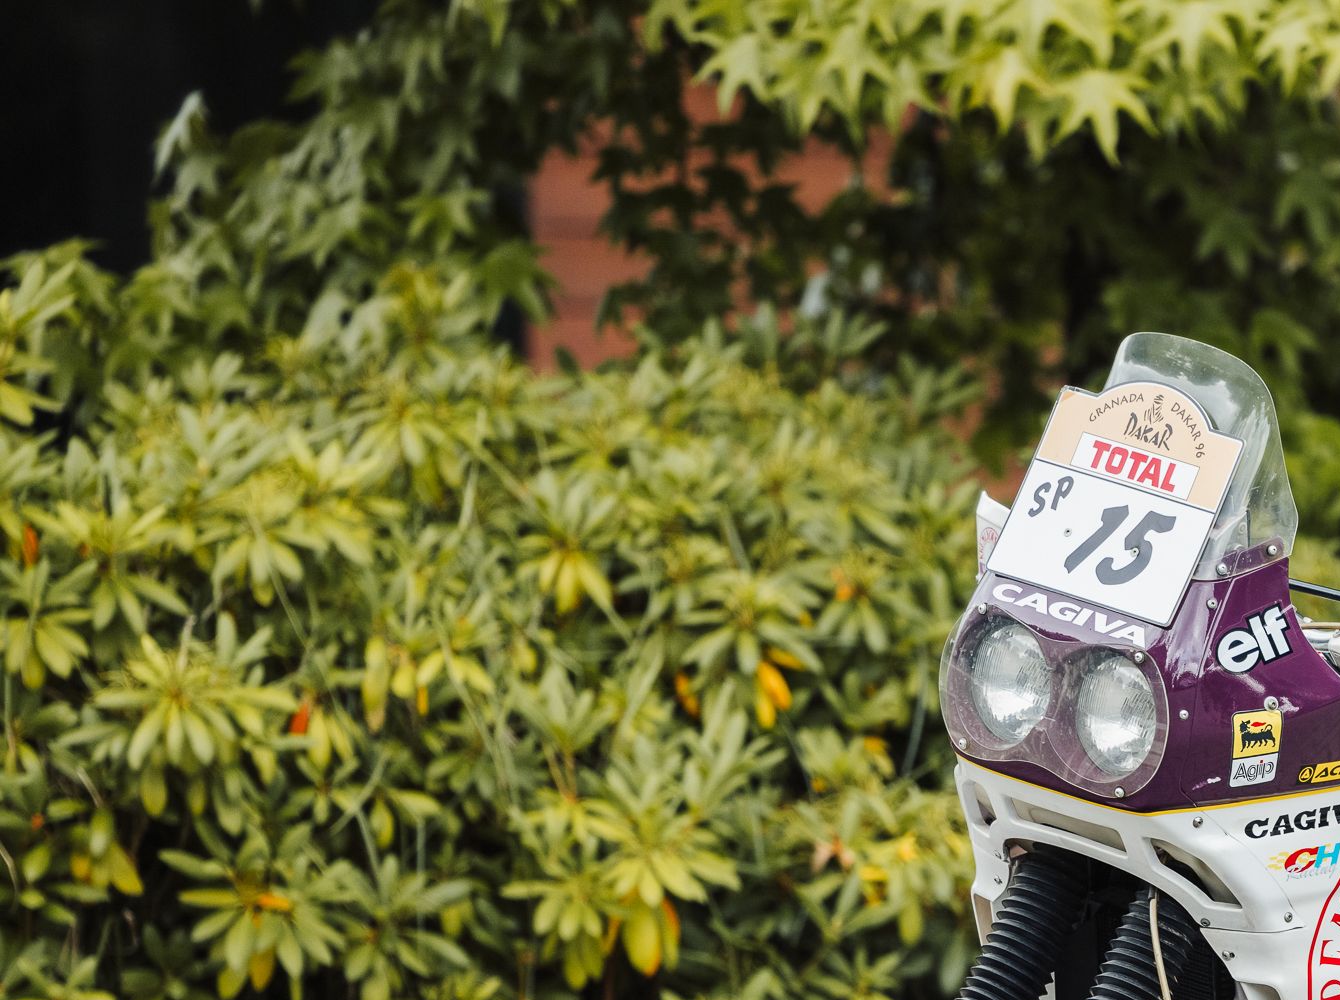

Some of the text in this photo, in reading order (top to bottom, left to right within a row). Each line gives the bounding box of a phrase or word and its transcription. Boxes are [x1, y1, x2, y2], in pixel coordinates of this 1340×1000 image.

[1088, 392, 1206, 459] GRANADA DAKAR 96
[1123, 411, 1174, 452] DAKAR
[1090, 439, 1177, 493] TOTAL
[1027, 475, 1075, 518] SP
[1063, 504, 1177, 586] 15
[991, 582, 1147, 649] CAGIVA
[1216, 604, 1291, 673] elf
[1232, 759, 1275, 782] Agip
